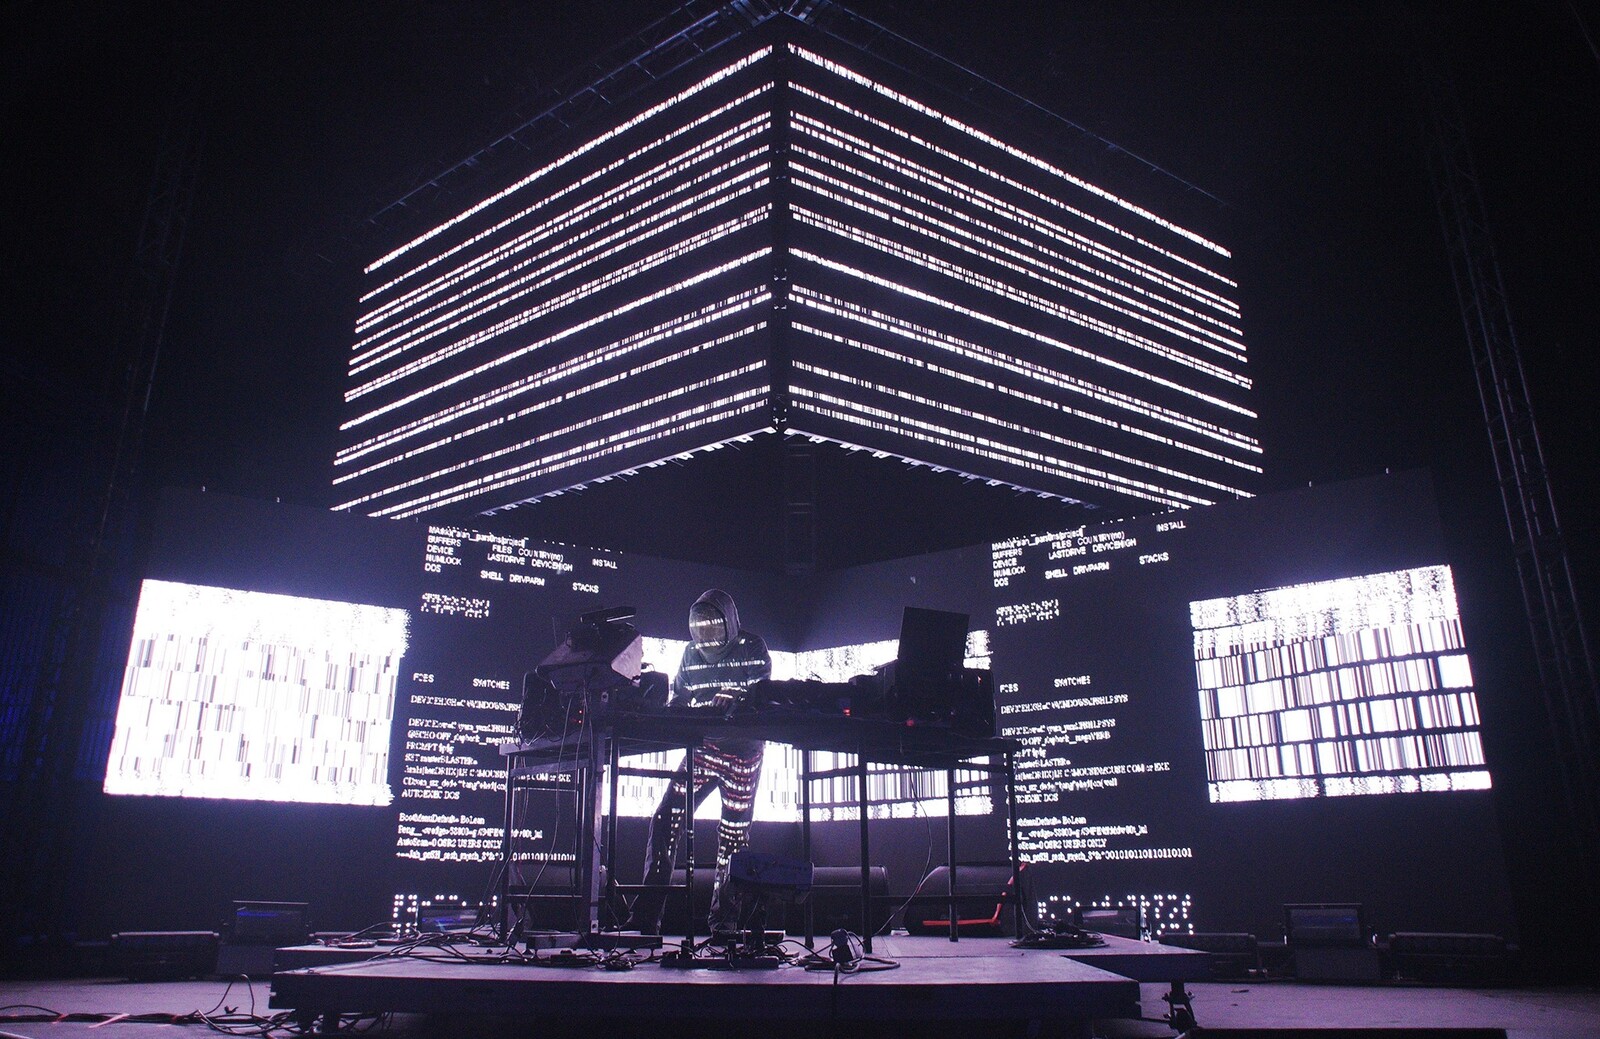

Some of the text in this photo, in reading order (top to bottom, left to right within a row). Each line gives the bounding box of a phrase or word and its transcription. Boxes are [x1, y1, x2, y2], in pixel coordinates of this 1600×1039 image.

[1156, 521, 1186, 532] INSTALL
[428, 536, 461, 547] BUFFERS
[1052, 540, 1072, 550] FILES
[427, 544, 453, 555] DEVICE
[492, 545, 512, 554] FILES
[992, 548, 1022, 559] BUFFERS
[1048, 547, 1086, 560] LASTDRIVE
[426, 554, 462, 565] NUMLOCK
[487, 553, 525, 565] LASTDRIVE
[592, 559, 617, 569] INSTALL
[993, 558, 1017, 569] DEVICE
[1139, 552, 1169, 565] STACKS
[425, 563, 441, 573] DOS
[993, 566, 1026, 577] NUMLOCK
[1045, 568, 1068, 579] SHELL
[480, 570, 503, 581] SHELL
[572, 582, 599, 593] STACKS
[994, 578, 1009, 587] DOS
